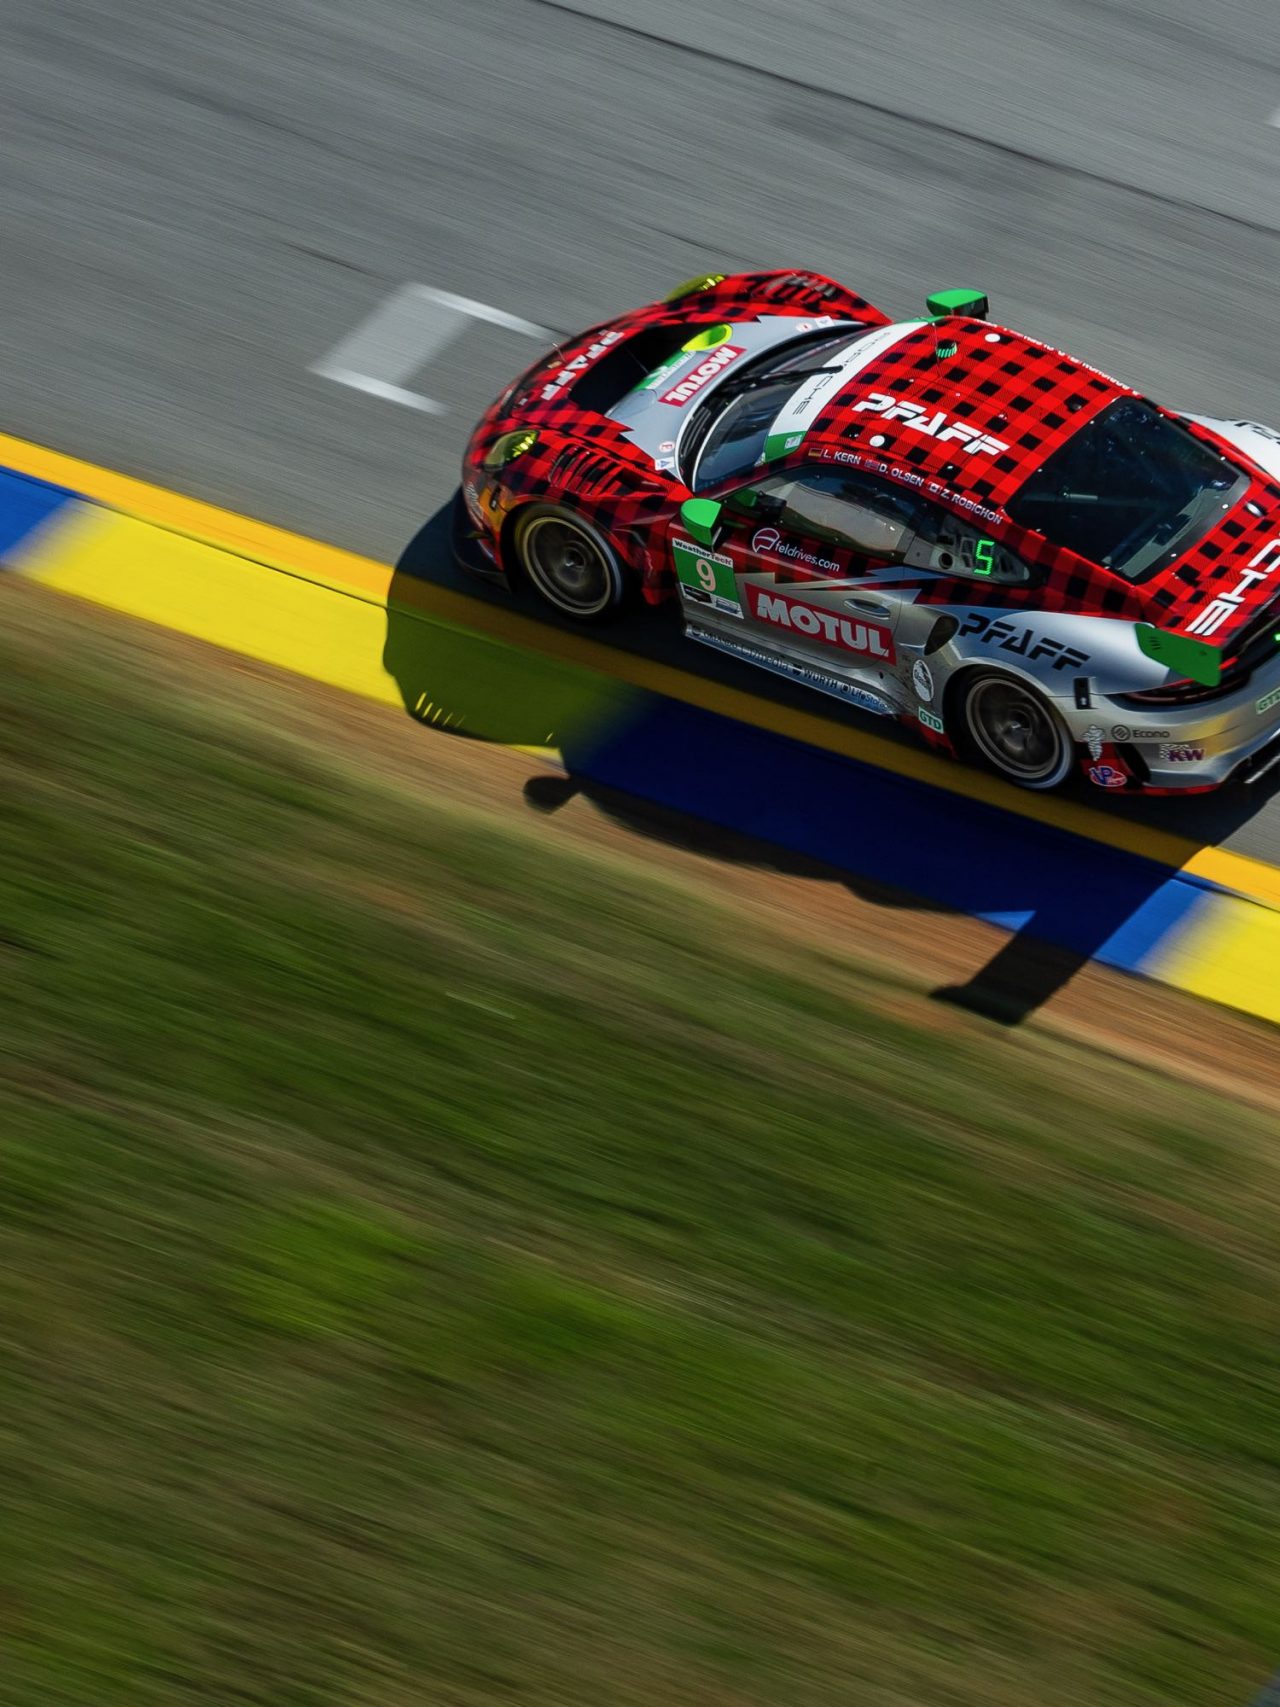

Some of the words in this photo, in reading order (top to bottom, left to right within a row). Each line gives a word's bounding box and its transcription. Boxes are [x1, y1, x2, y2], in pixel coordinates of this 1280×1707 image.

[664, 346, 738, 402] MOTUL
[852, 392, 1010, 456] PFAFF
[823, 449, 832, 458] L.
[834, 450, 861, 465] KERN
[879, 463, 889, 474] D.
[891, 468, 925, 487] OLSEN
[940, 488, 950, 499] Z.
[951, 493, 1003, 525] ROBICHON
[674, 540, 733, 567] WeatherTech
[774, 541, 840, 572] feldrives.com
[974, 539, 995, 575] 5
[696, 558, 716, 592] 9
[756, 592, 889, 658] MOTUL
[957, 612, 1091, 671] PFAFF
[919, 709, 942, 731] GTD
[1132, 729, 1170, 739] Econo
[1168, 748, 1205, 763] KW
[1089, 766, 1112, 785] VP
